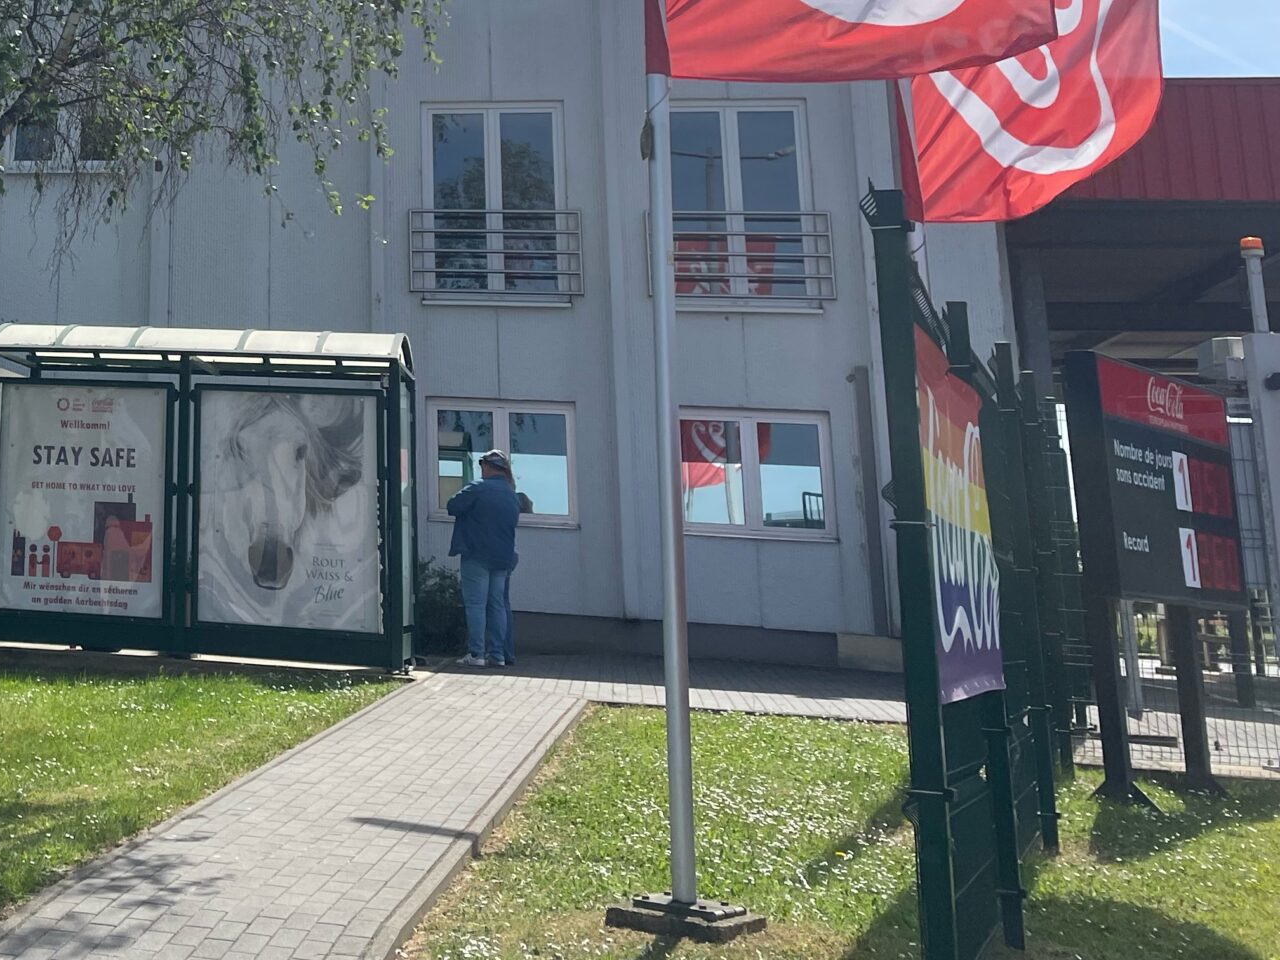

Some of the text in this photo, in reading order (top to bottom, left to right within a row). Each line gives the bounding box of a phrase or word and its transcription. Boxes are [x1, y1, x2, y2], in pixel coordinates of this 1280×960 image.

[1147, 376, 1184, 419] Coca-Cola
[32, 444, 136, 468] STAY SAFE
[1113, 438, 1189, 506] Nombre de jours 1
[1115, 467, 1166, 491] sans accident
[31, 481, 136, 492] GET HOME TO WHAT YOU LOVE
[1122, 531, 1197, 582] Record 1
[23, 581, 36, 590] Mir
[78, 583, 89, 592] dir
[344, 571, 354, 582] &
[43, 596, 72, 605] gudden
[314, 584, 344, 604] Blue
